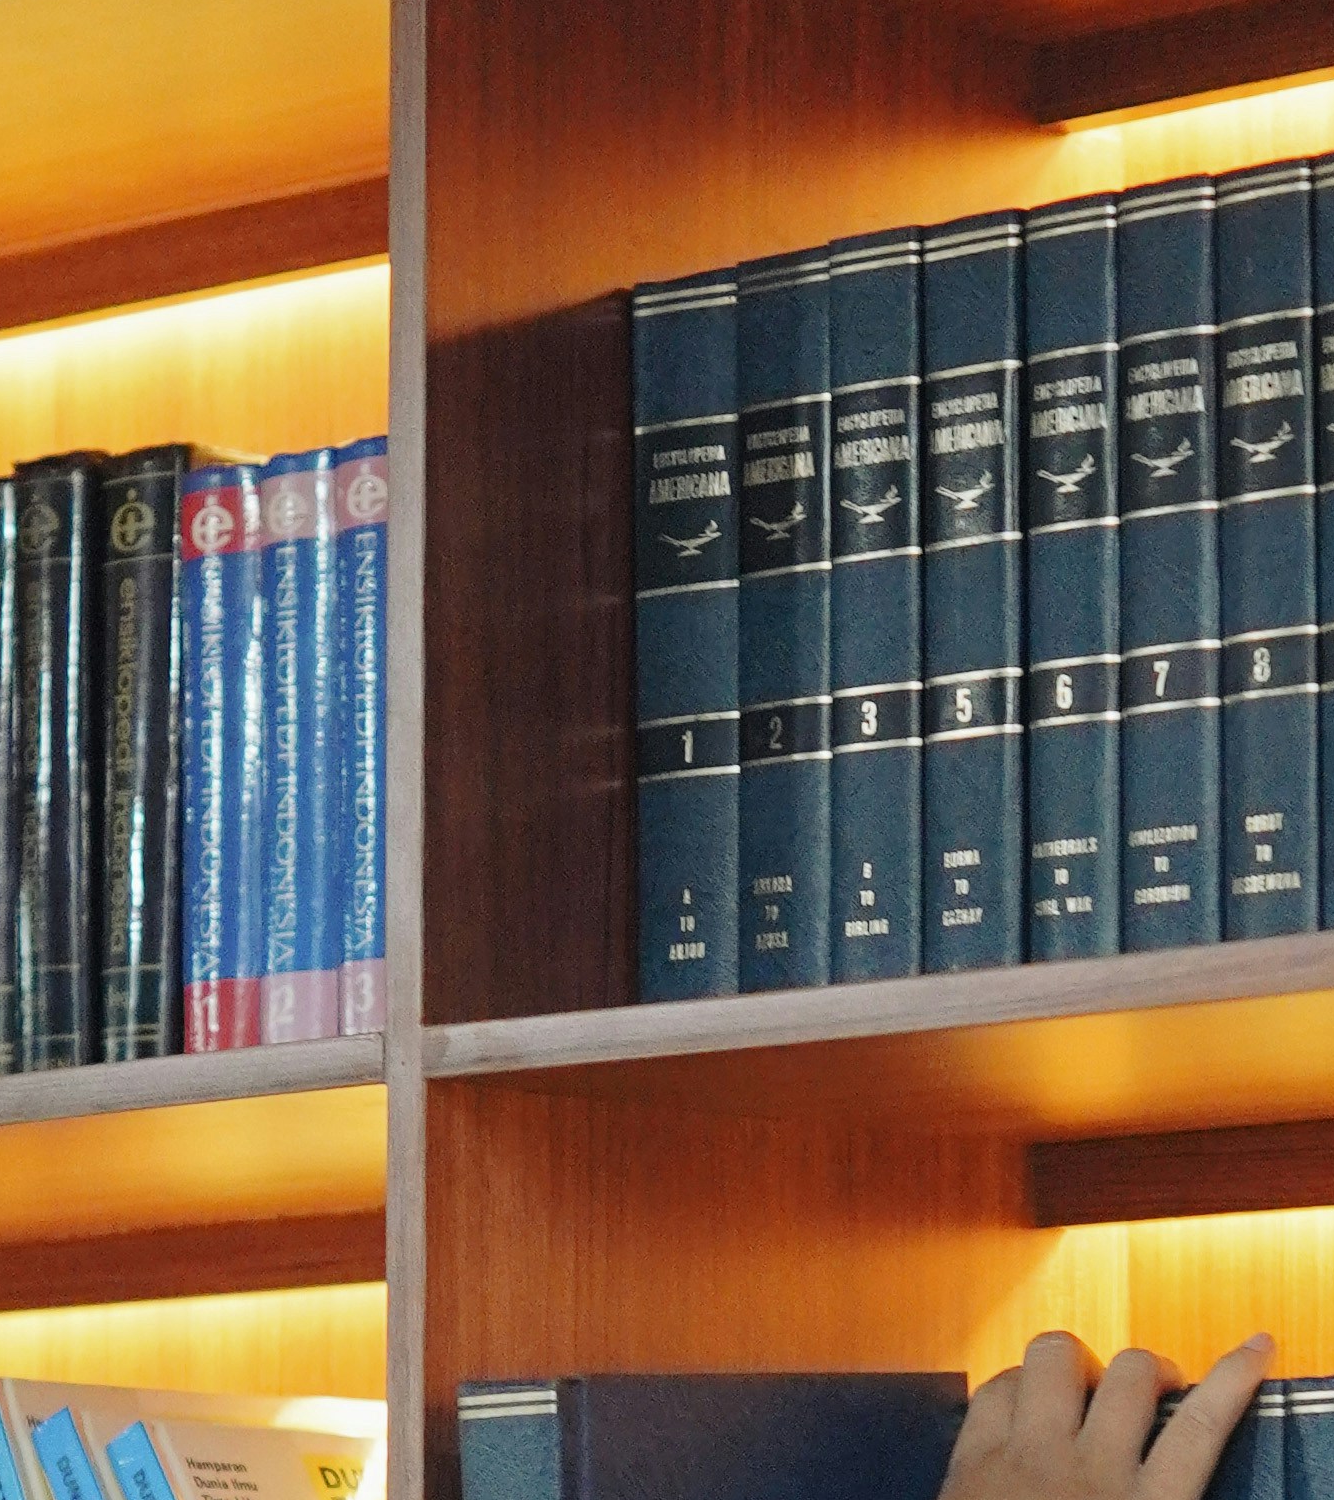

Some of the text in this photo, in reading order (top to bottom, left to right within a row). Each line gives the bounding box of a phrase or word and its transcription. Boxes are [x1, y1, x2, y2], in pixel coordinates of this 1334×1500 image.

[1153, 660, 1169, 697] 7
[1253, 647, 1271, 682] 8
[956, 688, 972, 722] 5
[1056, 674, 1073, 709] 6
[768, 716, 782, 749] 2
[861, 700, 877, 737] 3
[682, 730, 693, 763] 1
[356, 976, 375, 1016] 3
[185, 1457, 247, 1474] Hamparan
[193, 1476, 259, 1491] Dunia Ilmu
